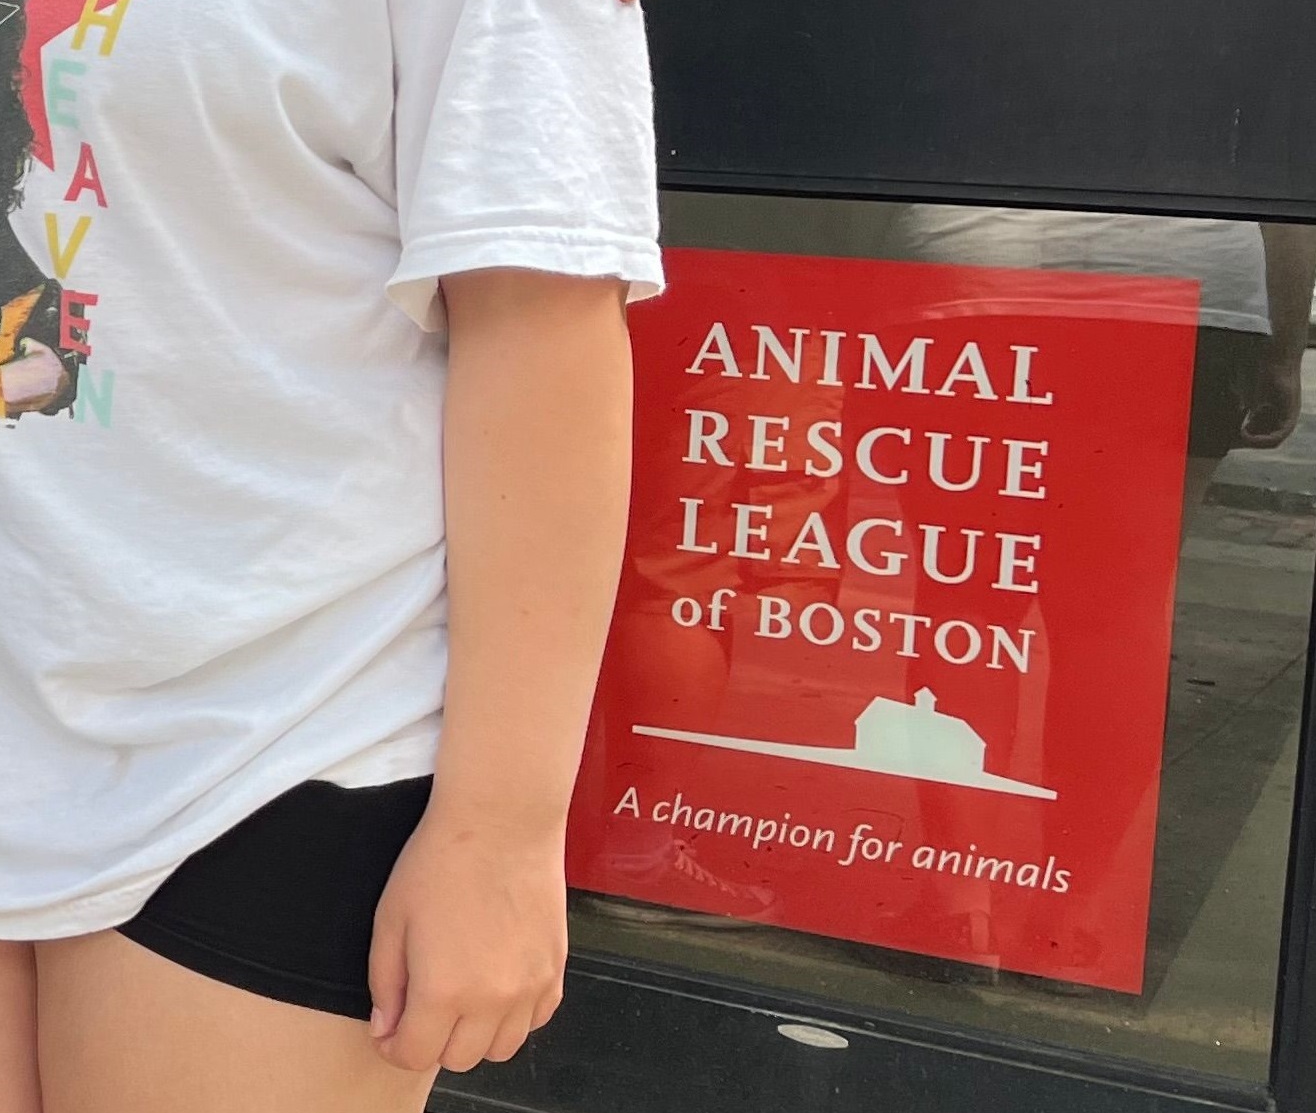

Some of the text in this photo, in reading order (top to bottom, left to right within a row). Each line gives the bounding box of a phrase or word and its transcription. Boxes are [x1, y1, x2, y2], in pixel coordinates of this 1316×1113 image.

[685, 320, 1054, 405] ANIMAL
[682, 408, 1050, 500] RESCUE
[676, 497, 1040, 594] LEAGUE
[671, 589, 1036, 674] of BOSTON
[614, 785, 1071, 893] A champion for animals
